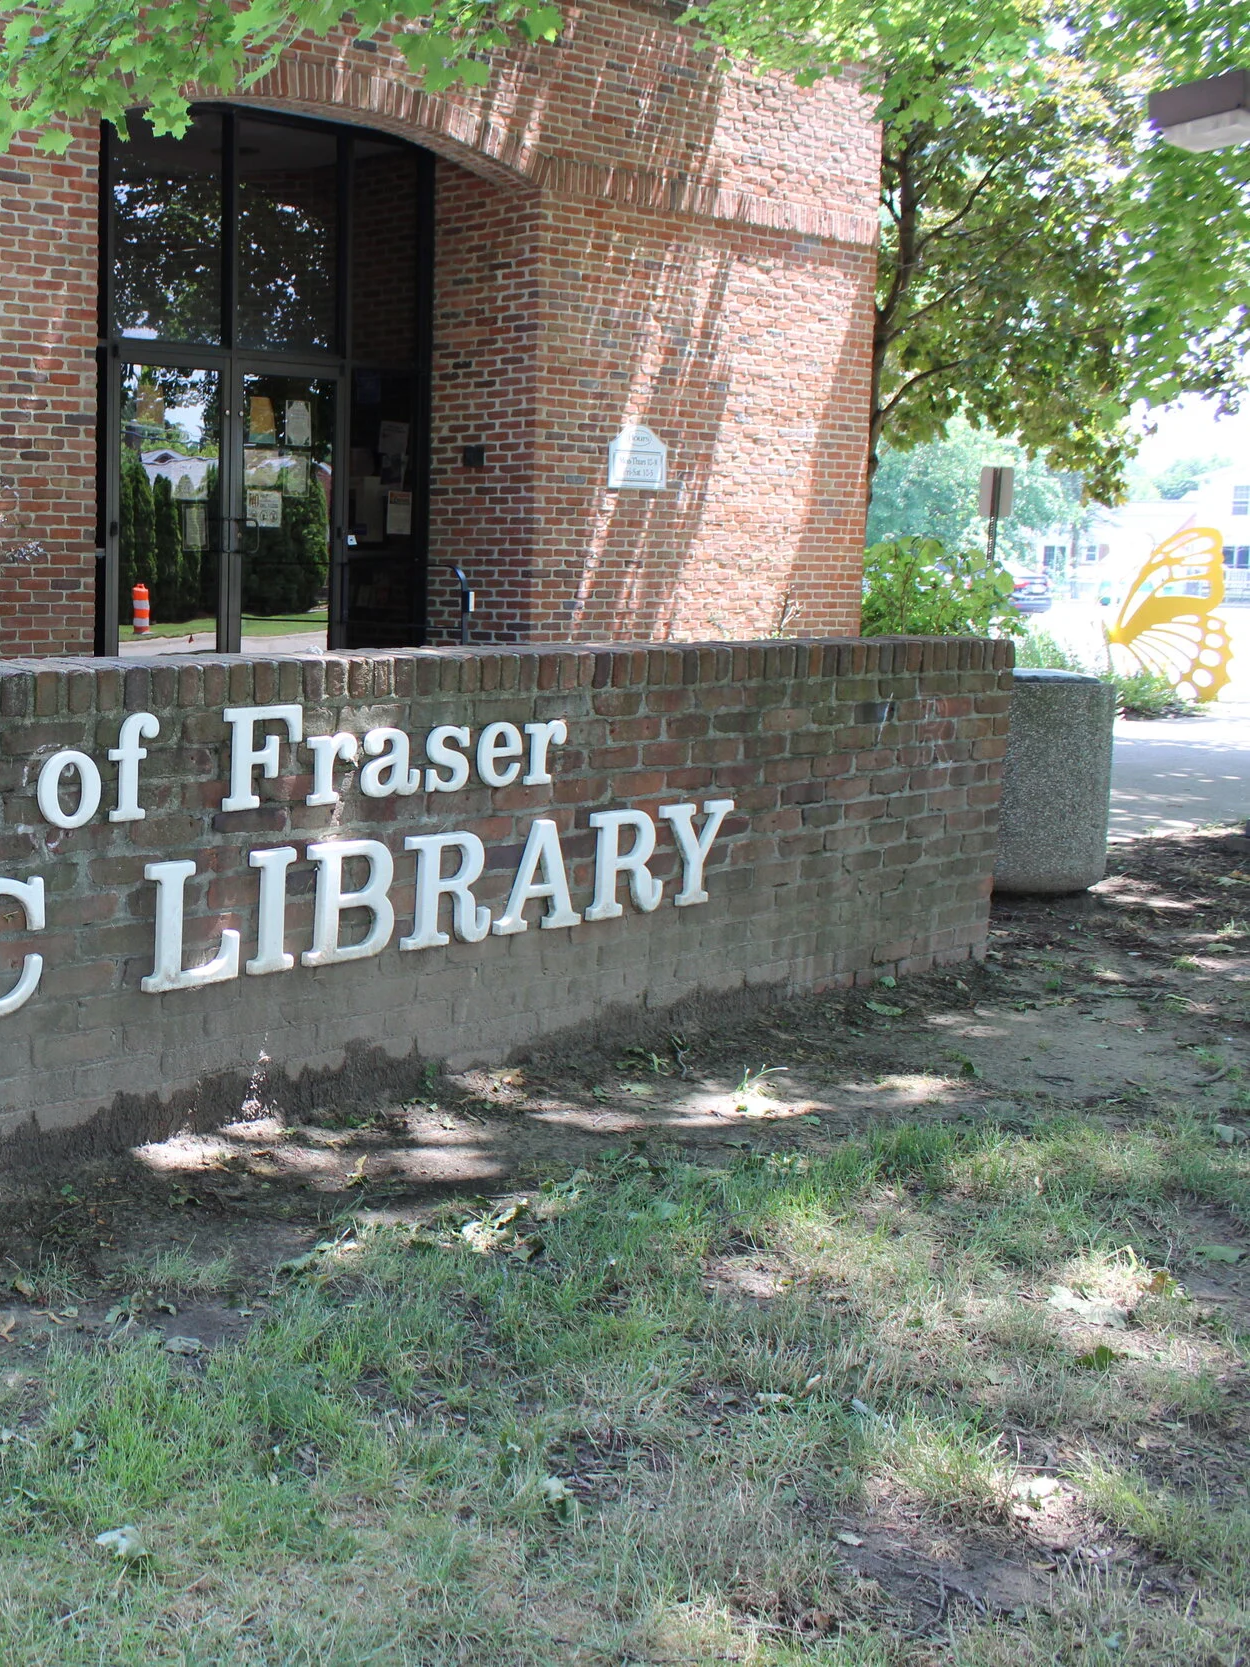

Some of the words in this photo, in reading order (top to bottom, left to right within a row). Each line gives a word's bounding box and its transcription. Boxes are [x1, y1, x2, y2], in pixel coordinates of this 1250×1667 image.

[623, 468, 641, 477] ri-Sat
[37, 712, 160, 830] of
[222, 704, 567, 812] Fraser
[140, 799, 735, 994] LIBRARY
